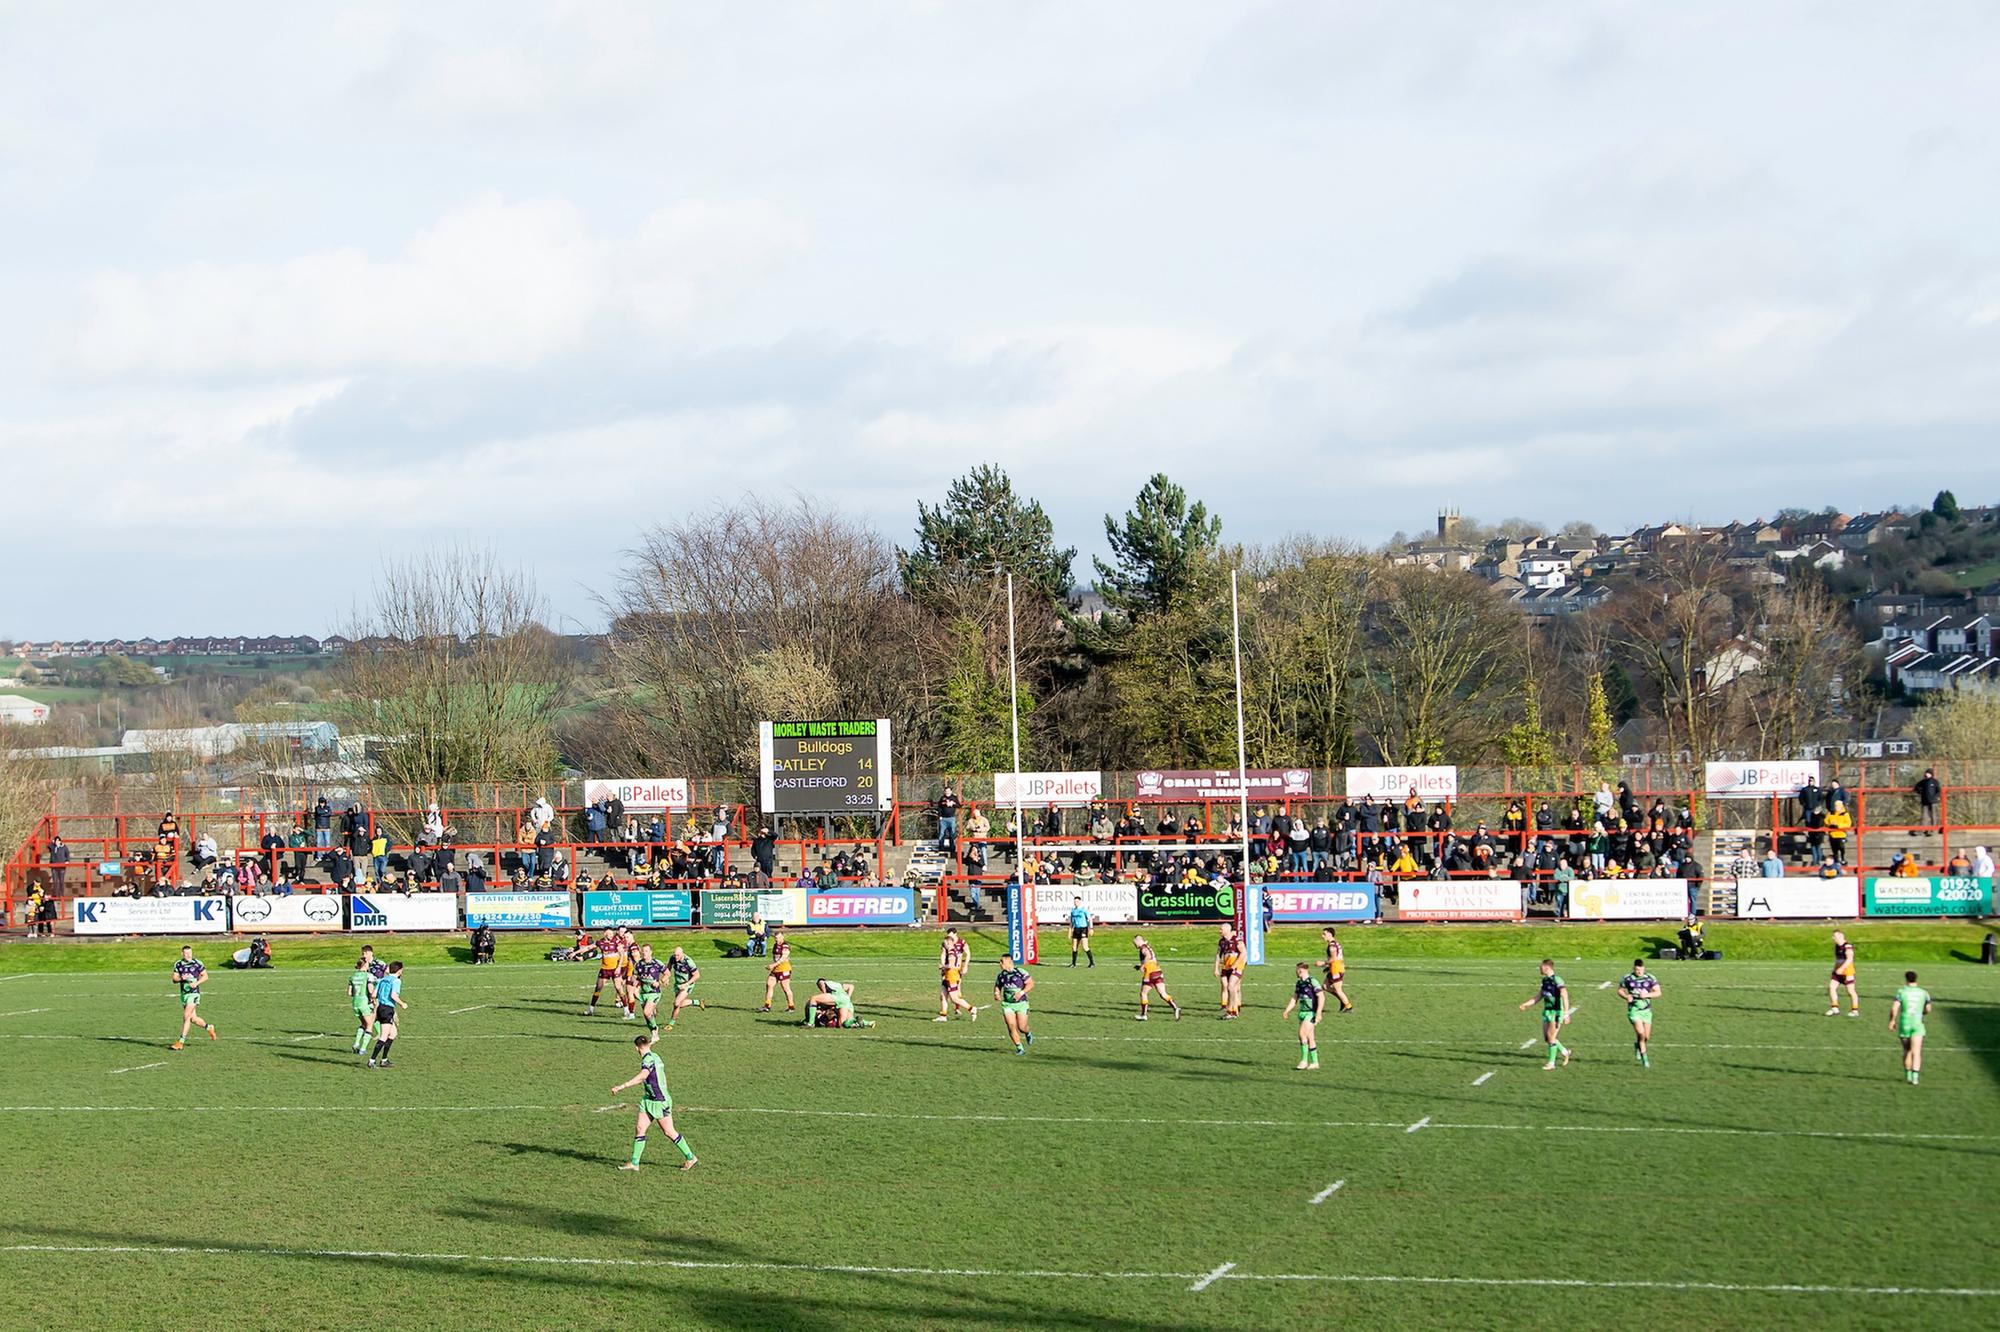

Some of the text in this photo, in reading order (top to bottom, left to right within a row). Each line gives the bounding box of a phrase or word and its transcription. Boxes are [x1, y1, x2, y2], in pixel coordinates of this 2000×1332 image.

[774, 722, 808, 736] MORLEY
[809, 722, 837, 736] WASTE
[839, 721, 876, 735] TRADERS
[798, 741, 853, 755] Bulldogs
[774, 758, 827, 771] BATLEY
[857, 758, 873, 770] 14
[774, 777, 848, 788] CASTLEFORD
[857, 776, 873, 788] 20
[1026, 779, 1097, 796] JBPallets
[1163, 778, 1212, 788] CRAIG
[1379, 773, 1452, 791] JBPallets
[618, 785, 684, 801] JBPallets
[845, 794, 874, 805] 33:25
[1940, 878, 1979, 889] 01924
[1140, 892, 1215, 909] Grassline
[1271, 892, 1369, 910] BETFRED
[1936, 889, 1983, 901] 420020
[618, 904, 643, 912] STREET
[812, 898, 908, 915] BETFRED
[1874, 904, 1984, 914] watsonsweb.co.uk
[353, 914, 387, 927] DMR
[1236, 889, 1244, 940] BETFR
[1010, 888, 1021, 961] BETFRED
[1024, 887, 1035, 960] BETFRED
